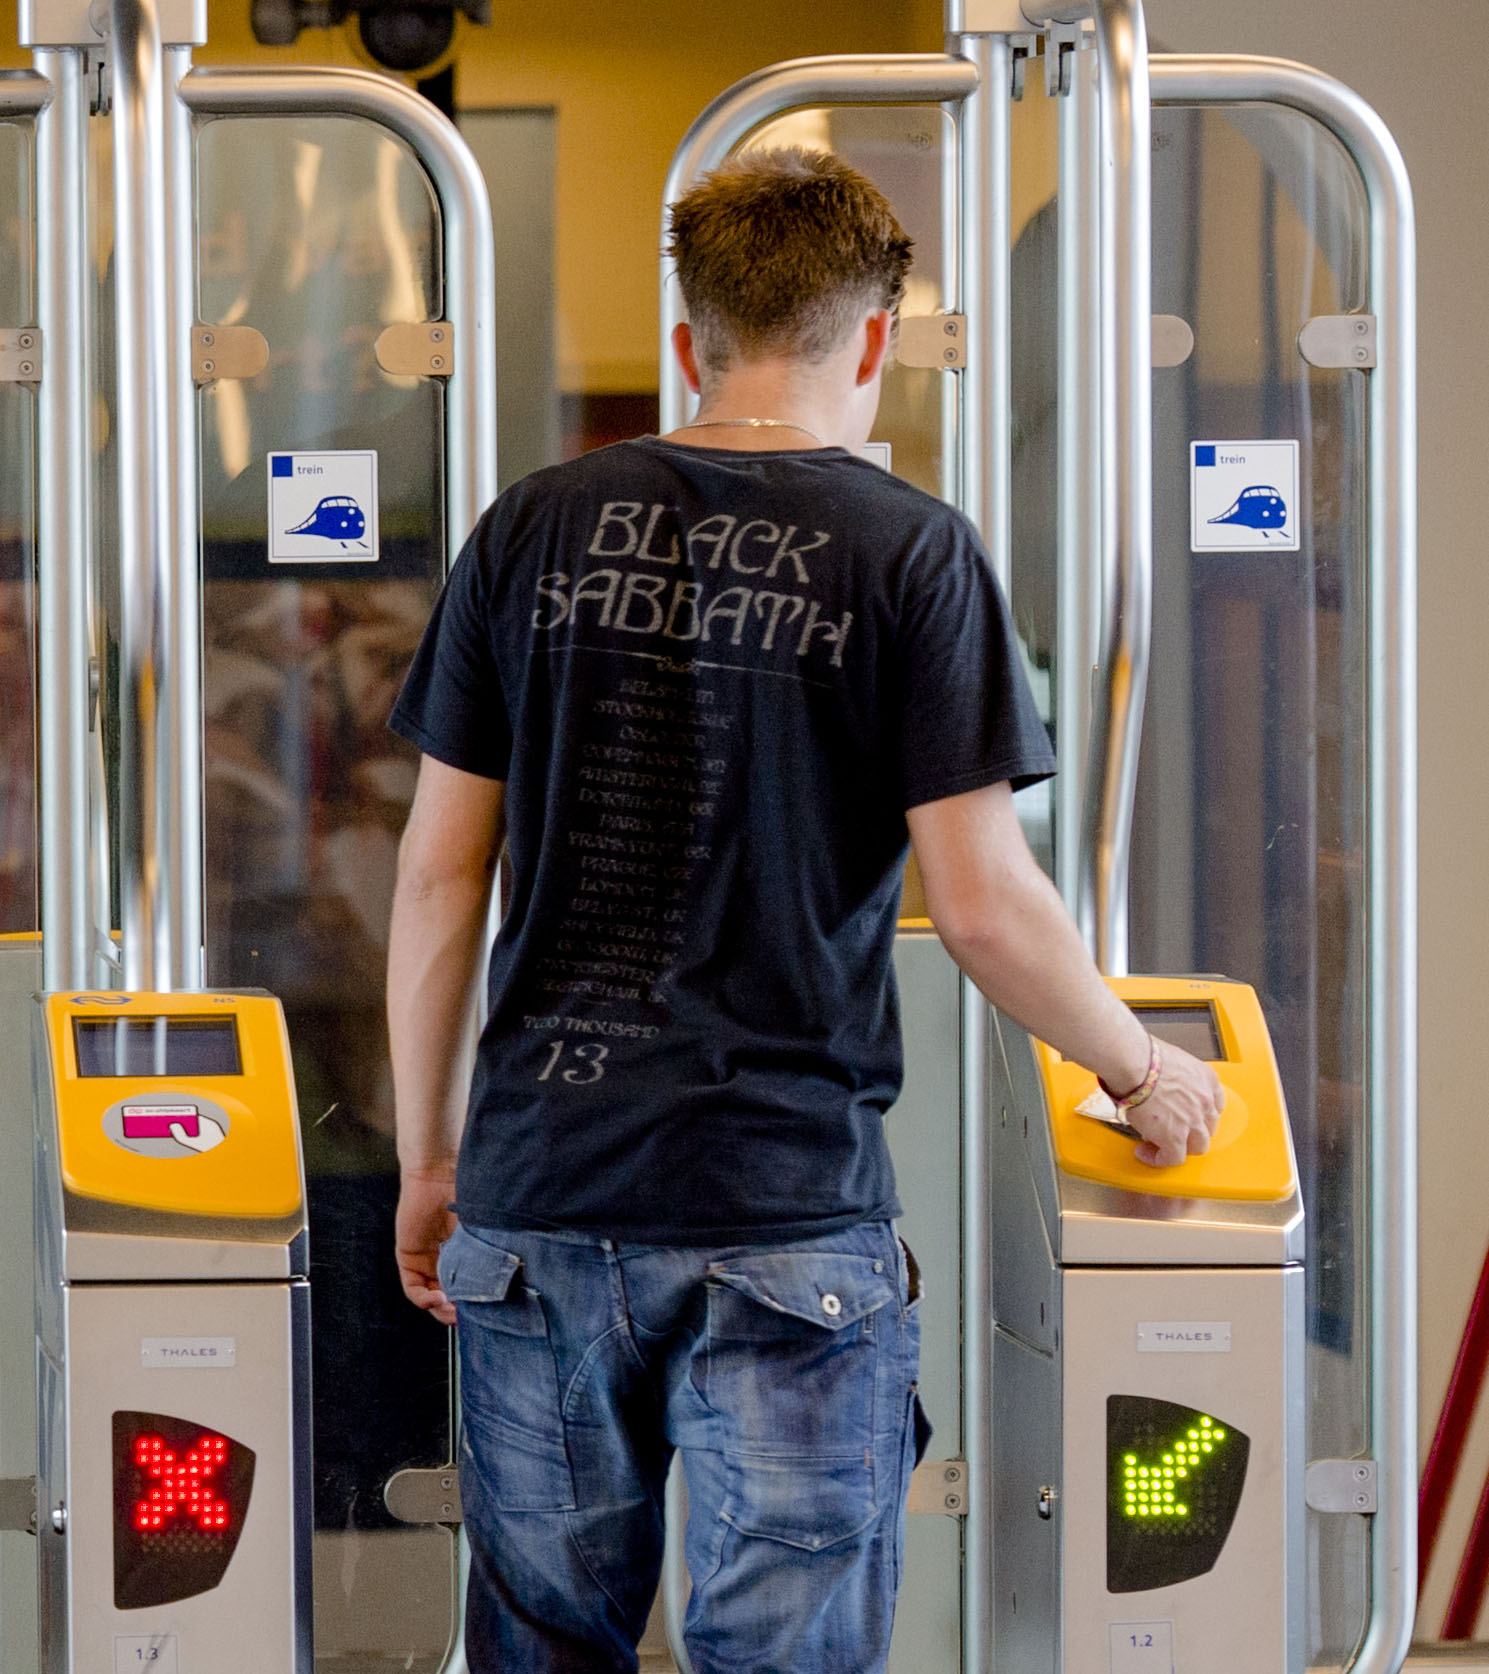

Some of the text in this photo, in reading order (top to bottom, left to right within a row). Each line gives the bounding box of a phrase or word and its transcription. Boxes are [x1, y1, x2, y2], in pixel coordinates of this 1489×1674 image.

[1219, 453, 1246, 464] trein
[297, 464, 324, 475] trein
[587, 501, 831, 583] BLACK
[532, 568, 853, 668] SABBATH
[524, 1015, 660, 1039] TWO THOUSAND
[538, 1040, 609, 1085] 13
[1155, 1332, 1212, 1341] THALES
[160, 1348, 217, 1357] THALES
[1130, 1634, 1153, 1648] 1.2
[136, 1648, 158, 1660] 1.3
